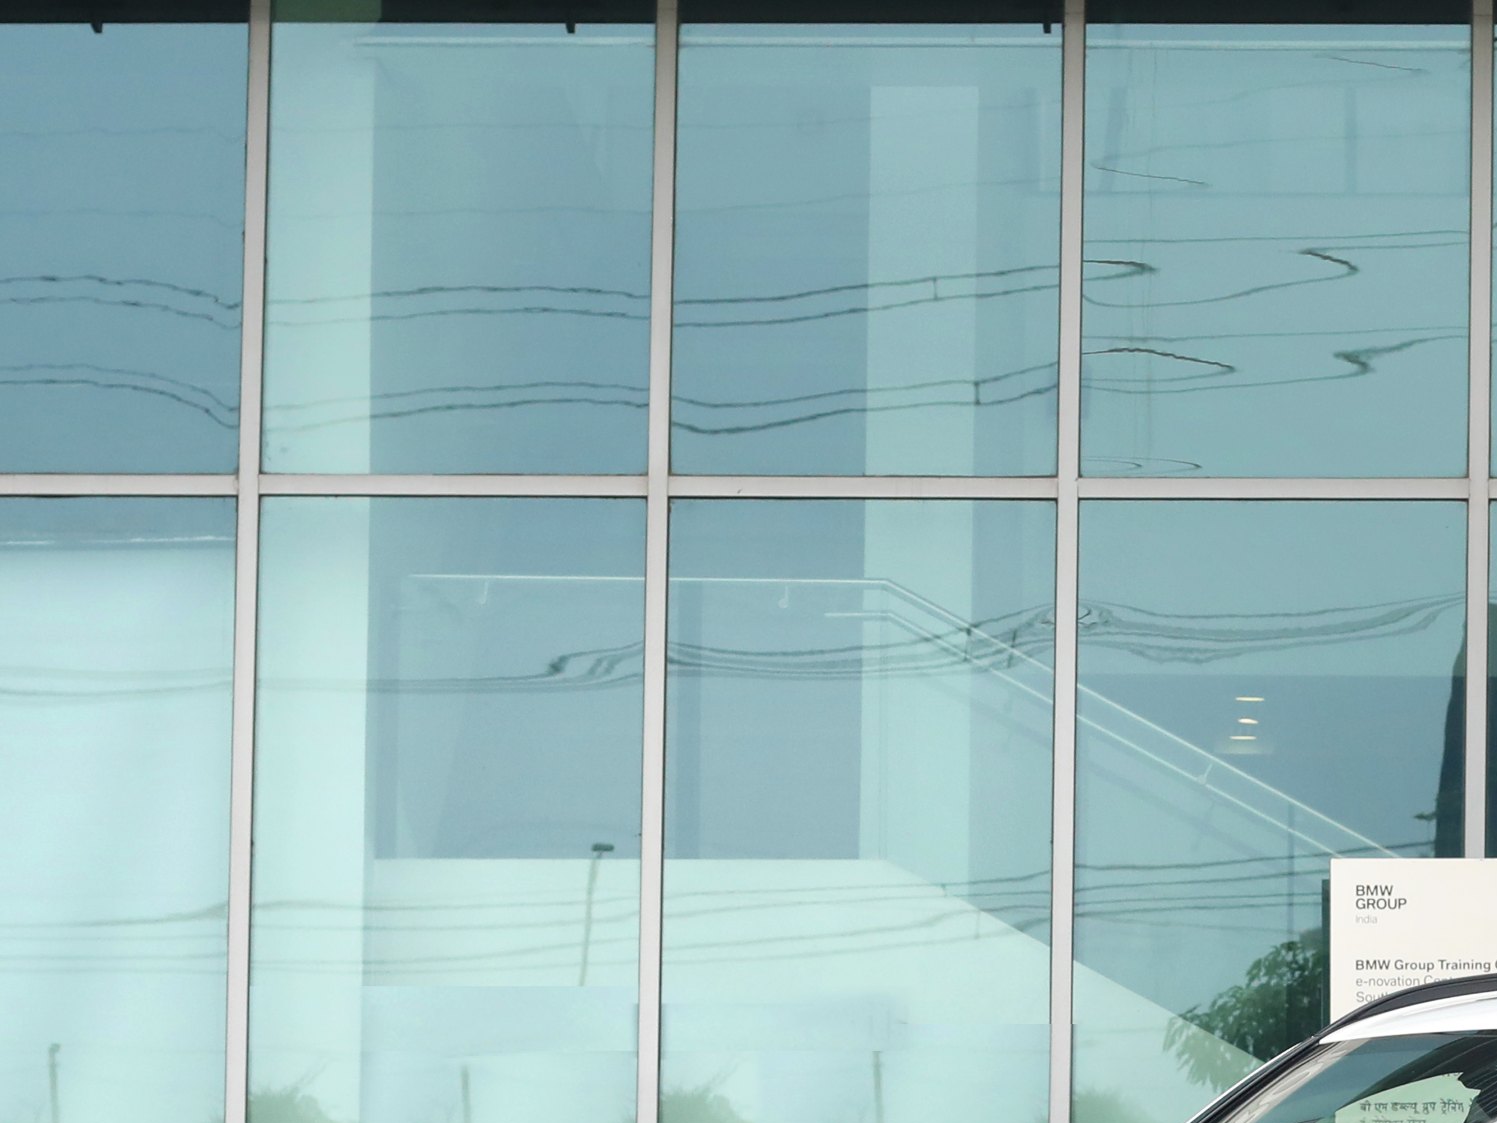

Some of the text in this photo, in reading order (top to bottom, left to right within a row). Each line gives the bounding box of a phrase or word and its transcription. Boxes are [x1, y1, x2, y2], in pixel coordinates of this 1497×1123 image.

[1355, 884, 1394, 897] BMW
[1355, 898, 1408, 910] GROUP
[1355, 914, 1378, 925] India
[1355, 959, 1391, 971] BMW
[1394, 959, 1435, 973] Group
[1438, 959, 1491, 973] Training
[1355, 975, 1421, 987] e-novation
